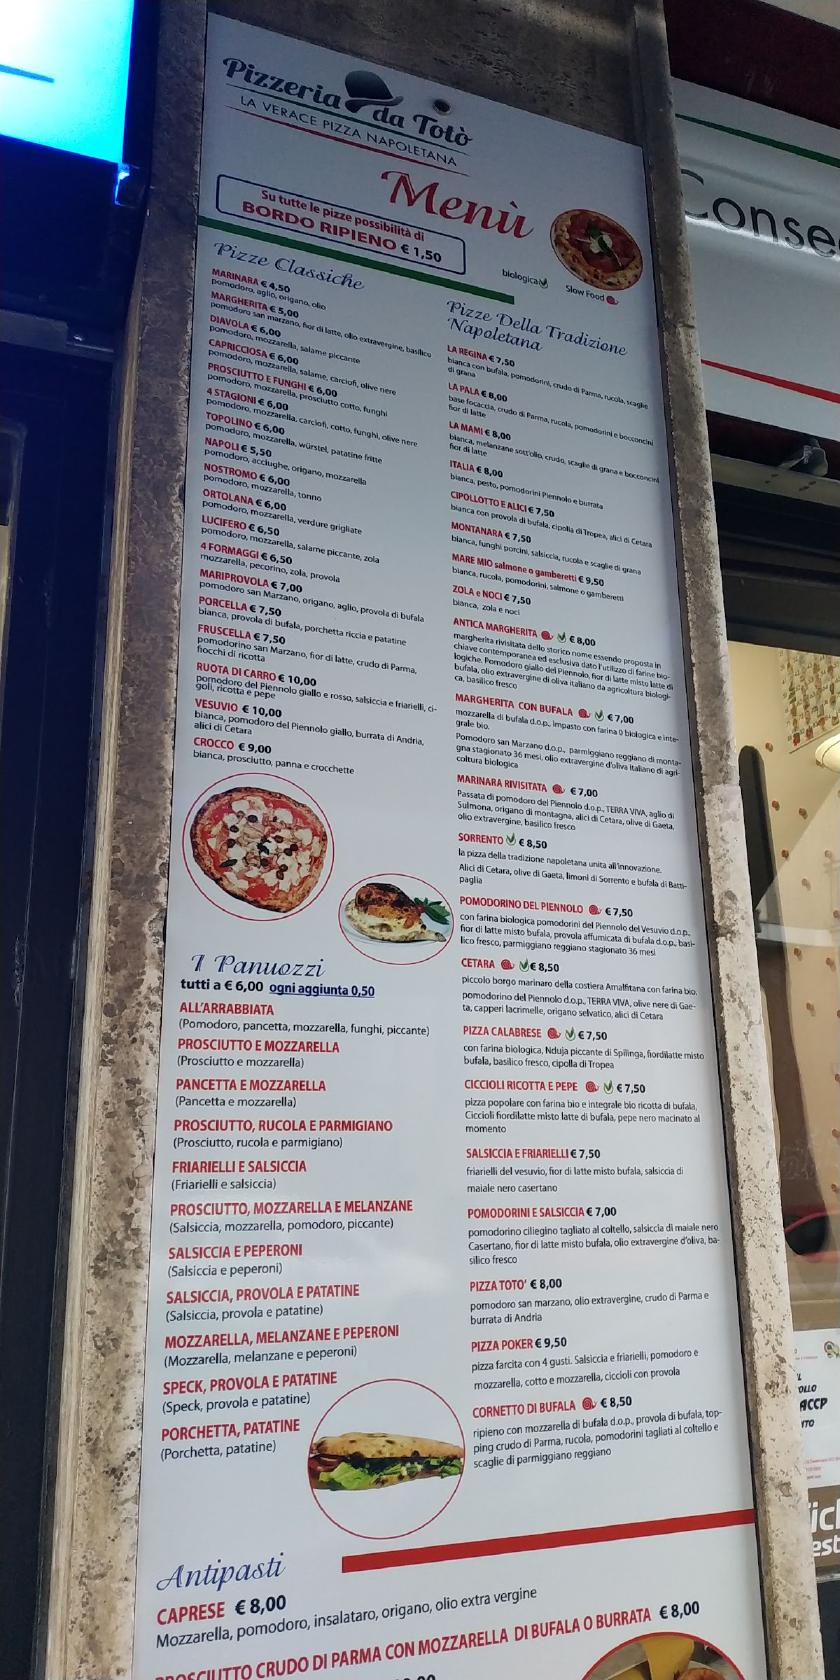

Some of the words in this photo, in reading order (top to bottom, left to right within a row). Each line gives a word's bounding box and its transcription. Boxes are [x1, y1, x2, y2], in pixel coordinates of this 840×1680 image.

[222, 57, 341, 110] Pizzeria
[372, 106, 405, 129] da
[413, 113, 472, 147] Totò
[240, 95, 257, 109] LA
[262, 101, 318, 126] VERACE
[323, 120, 360, 138] PIZZA
[367, 132, 457, 166] NAPOLETANA
[261, 189, 276, 202] Su
[278, 193, 306, 211] tutte
[309, 201, 320, 213] le
[322, 205, 351, 224] pizze
[354, 211, 411, 239] possibilità
[413, 230, 425, 242] di
[380, 170, 535, 239] Menù
[681, 168, 840, 258] Conse
[242, 200, 315, 230] BORDO
[320, 221, 397, 251] RIPIENO
[400, 244, 410, 256] €
[414, 246, 442, 266] 1,50
[213, 242, 269, 266] Pizze
[274, 257, 365, 290] Classiche
[501, 269, 538, 286] biologica
[211, 268, 259, 286] MARINARA
[268, 282, 291, 293] 4,50
[565, 284, 586, 299] Slow
[588, 288, 605, 302] Food
[447, 300, 492, 322] Pizze
[496, 313, 543, 335] Della
[546, 325, 628, 356] Tradizione
[448, 318, 543, 351] Napoletana
[208, 339, 268, 359] CAPRICCIOSA
[277, 354, 299, 365] 6,00
[204, 463, 257, 480] NOSTROMO
[268, 475, 290, 487] 6,00
[203, 474, 249, 489] pomodoro,
[251, 483, 297, 498] mozzarella,
[298, 492, 322, 501] tonno
[451, 522, 503, 538] MONTANARA
[512, 533, 531, 543] 7,50
[200, 542, 207, 550] 4
[208, 543, 259, 559] FORMAGGI
[261, 552, 268, 560] €
[270, 553, 292, 565] 6,50
[200, 568, 269, 588] MARIPROVOLA
[271, 581, 277, 589] €
[279, 582, 302, 593] 7,00
[452, 599, 479, 609] bianca,
[504, 607, 520, 615] noci
[453, 618, 484, 630] ANTICA
[486, 621, 537, 637] MARGHERITA
[577, 636, 596, 646] 8,00
[195, 698, 238, 712] VESUVIO
[242, 705, 249, 713] €
[252, 706, 282, 718] 10,00
[455, 693, 515, 708] MARGHERITA
[518, 701, 538, 711] CON
[539, 704, 573, 717] BUFALA
[607, 714, 613, 722] €
[615, 714, 634, 724] 7,00
[193, 737, 234, 750] CROCCO
[238, 743, 245, 751] €
[248, 743, 272, 754] 9,00
[193, 750, 225, 762] bianca,
[227, 755, 273, 767] prosciutto,
[275, 759, 302, 769] panna
[311, 763, 354, 774] crocchette
[458, 833, 504, 845] SORRENTO
[519, 838, 525, 847] €
[527, 838, 547, 849] 8,50
[214, 954, 327, 977] Panuozzi
[181, 978, 210, 990] tutti
[213, 982, 221, 990] a
[225, 981, 232, 990] €
[235, 981, 264, 992] 6,00
[269, 982, 295, 995] ogni
[298, 985, 348, 997] aggiunta
[351, 986, 375, 997] 0,50
[179, 1019, 240, 1031] (Pomodoro,
[243, 1021, 291, 1032] pancetta,
[293, 1023, 348, 1034] mozzarella,
[351, 1024, 384, 1035] funghi,
[387, 1025, 430, 1036] piccante)
[174, 1120, 255, 1133] PROSCIUTTO,
[258, 1120, 306, 1131] RUCOLA
[310, 1120, 316, 1131] E
[319, 1121, 393, 1131] PARMIGIANO
[173, 1137, 234, 1149] (Prosciutto,
[236, 1137, 269, 1147] rucola
[272, 1139, 278, 1147] e
[281, 1137, 343, 1149] parmigiano)
[467, 1183, 495, 1193] maiale
[518, 1184, 557, 1192] casertano
[168, 1247, 230, 1260] SALSICCIA
[234, 1246, 240, 1257] E
[244, 1244, 303, 1257] PEPERONI
[168, 1265, 217, 1278] (Salsiccia
[230, 1263, 283, 1277] peperoni)
[470, 1280, 497, 1292] PIZZA
[530, 1279, 537, 1289] €
[539, 1278, 562, 1290] 8,00
[471, 1314, 502, 1325] burrata
[504, 1314, 512, 1323] di
[515, 1313, 542, 1322] Andria
[473, 1404, 525, 1419] CORNETTO
[527, 1404, 537, 1414] DI
[539, 1400, 576, 1413] BUFALA
[600, 1398, 607, 1408] €
[609, 1395, 632, 1407] 8,50
[799, 1398, 828, 1411] ACCP
[161, 1422, 240, 1442] PORCHETTA,
[243, 1419, 300, 1435] PATATINE
[161, 1444, 224, 1461] (Porchetta,
[226, 1440, 276, 1456] patatine)
[156, 1552, 286, 1591] Antipasti
[156, 1625, 233, 1648] Mozzarella,
[237, 1617, 311, 1642] pomodoro,
[314, 1607, 379, 1628] insalataro,
[381, 1602, 433, 1619] origano,
[435, 1596, 459, 1610] olio
[461, 1593, 491, 1608] extra
[494, 1587, 537, 1606] vergine
[157, 1601, 225, 1625] CAPRESE
[235, 1600, 246, 1615] €
[249, 1595, 287, 1614] 8,00
[256, 1657, 309, 1677] CRUDO
[312, 1653, 328, 1669] DI
[332, 1646, 382, 1666] PARMA
[385, 1641, 415, 1660] CON
[418, 1628, 508, 1653] MOZZARELLA
[514, 1626, 528, 1641] DI
[531, 1618, 580, 1638] BUFALA
[583, 1616, 593, 1630] O
[596, 1607, 652, 1629] BURRATA
[659, 1606, 668, 1619] €
[671, 1601, 700, 1618] 8,00
